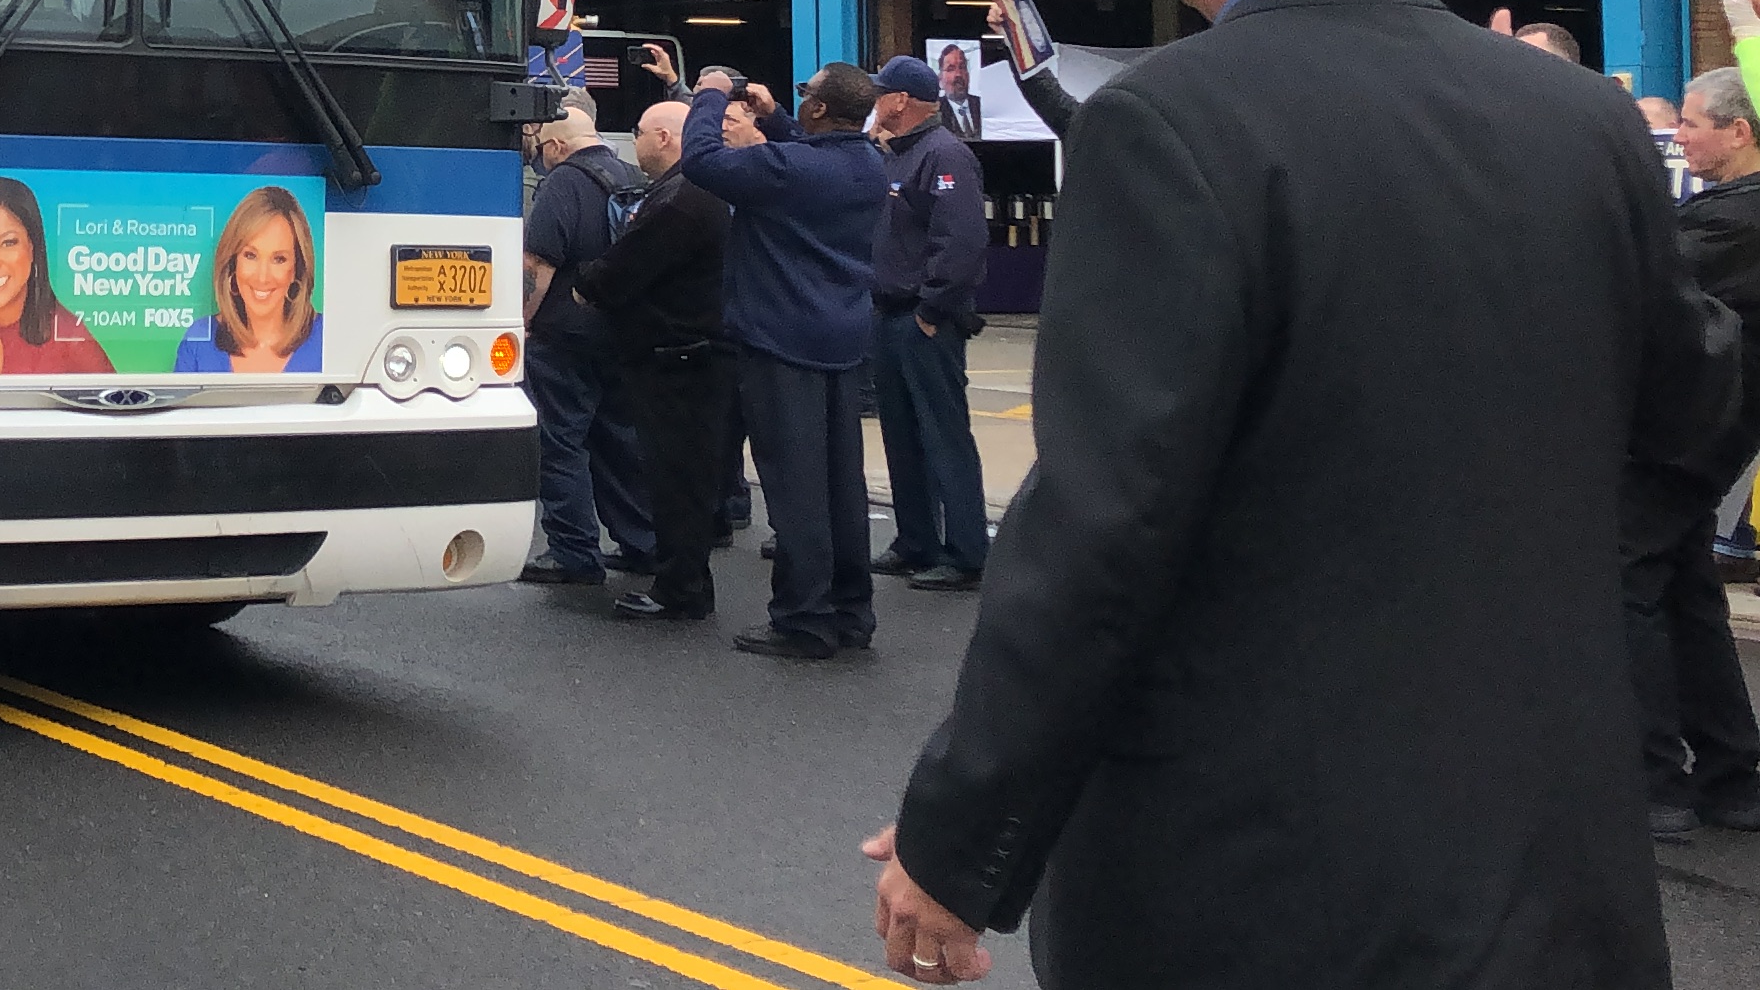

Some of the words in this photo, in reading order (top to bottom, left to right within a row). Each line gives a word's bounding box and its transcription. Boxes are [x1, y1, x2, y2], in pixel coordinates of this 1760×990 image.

[75, 218, 108, 235] Lori
[112, 219, 124, 235] &
[127, 219, 197, 236] Rosanna
[68, 245, 145, 272] Good
[147, 246, 201, 279] Day
[421, 250, 445, 259] NEW
[446, 250, 471, 260] YORK
[73, 273, 133, 296] New
[134, 273, 191, 296] York
[449, 264, 488, 293] 3202
[75, 310, 136, 327] 7-10AM
[144, 308, 194, 327] FOX5
